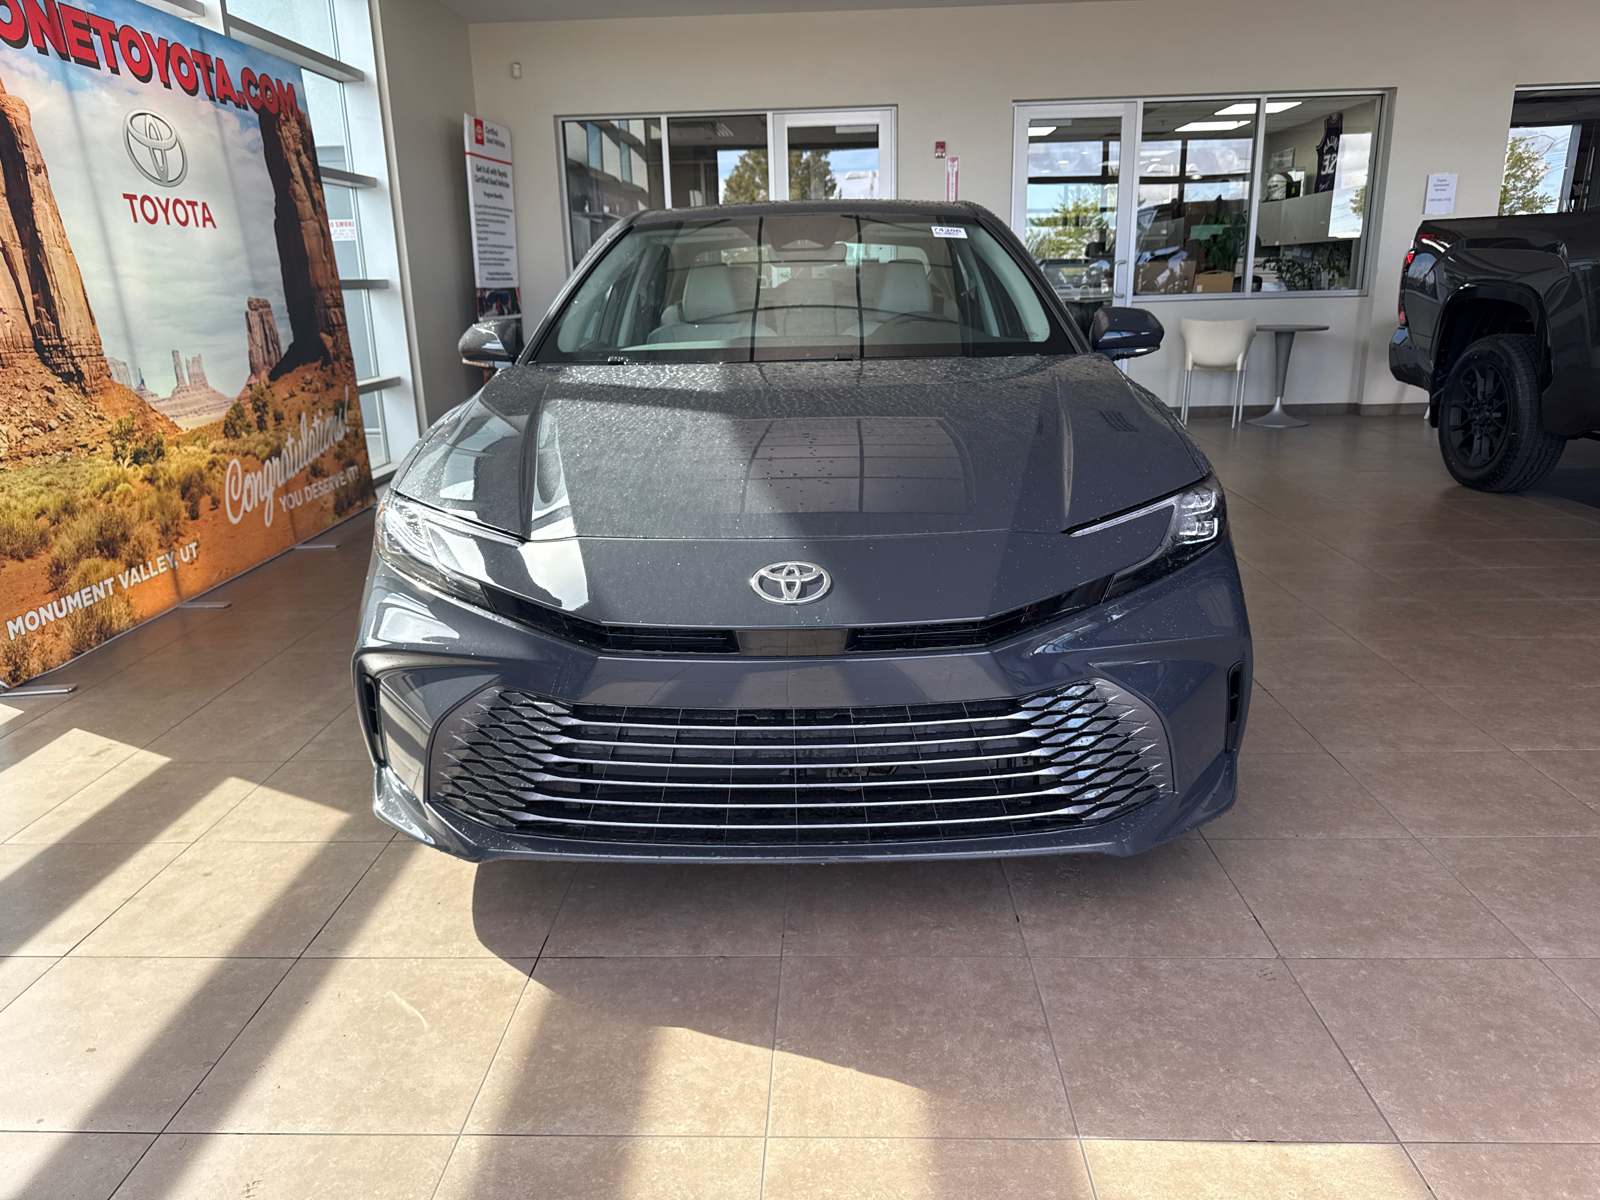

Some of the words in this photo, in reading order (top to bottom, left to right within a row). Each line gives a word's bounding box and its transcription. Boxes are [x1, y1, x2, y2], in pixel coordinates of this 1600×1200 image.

[1320, 154, 1338, 175] 32
[122, 193, 217, 229] TOYOTA
[225, 384, 350, 528] Congratulations!
[278, 490, 302, 512] YOU
[304, 470, 347, 502] DESERVE
[6, 576, 116, 640] MONUMENT
[117, 552, 179, 590] VALLEY,
[180, 541, 200, 564] UT
